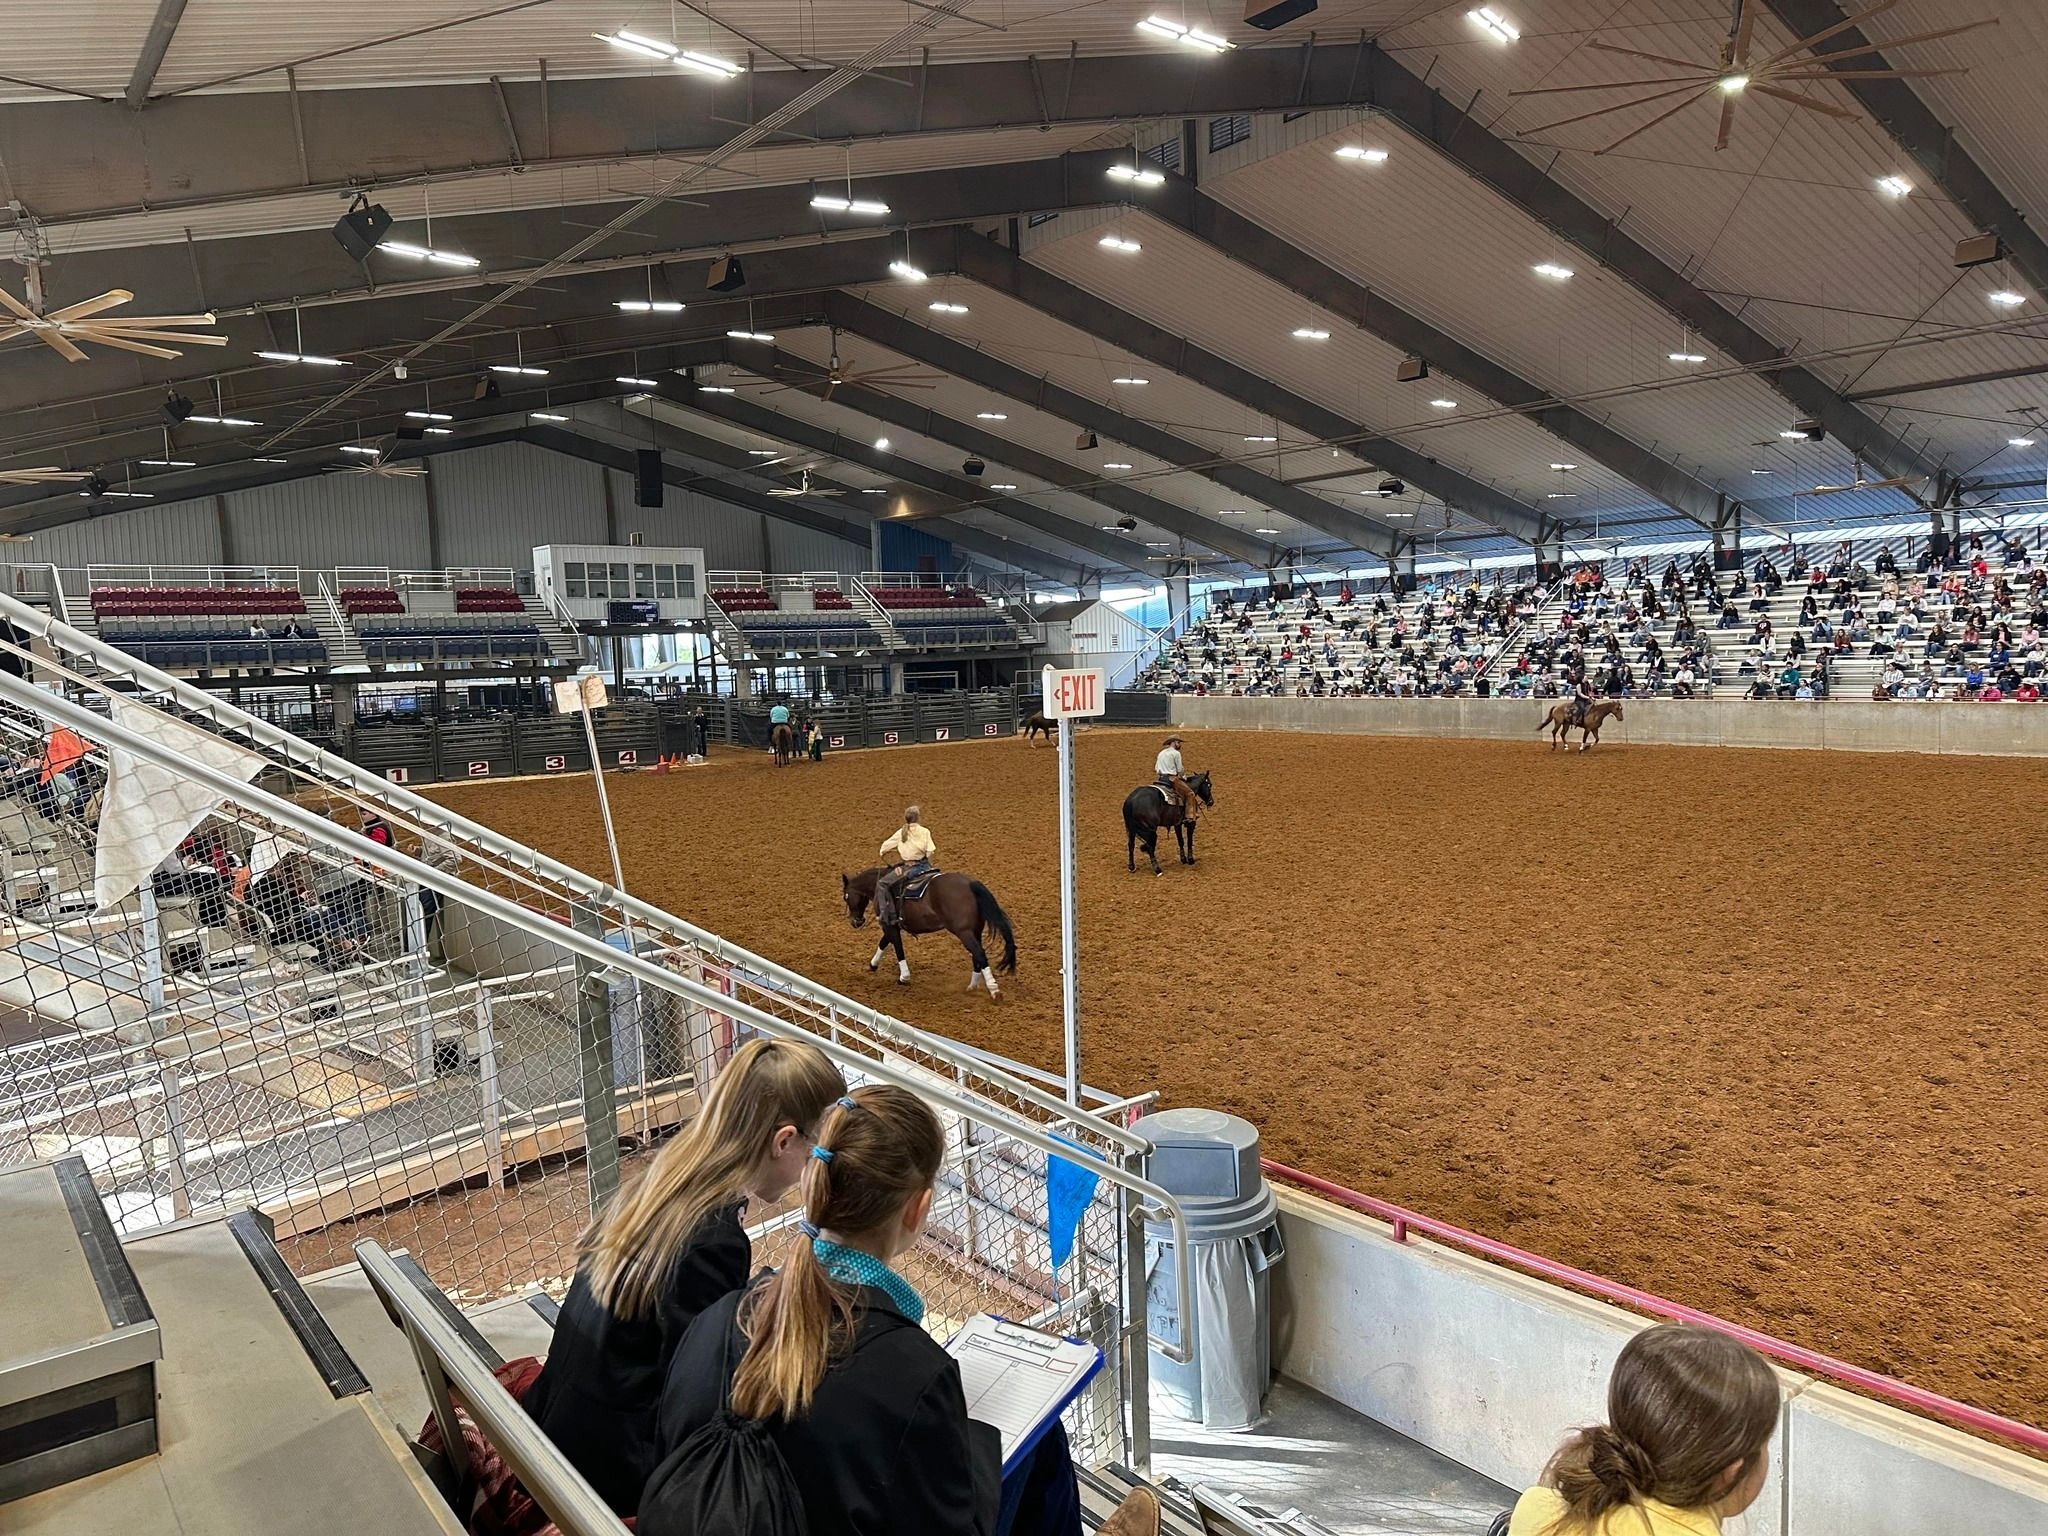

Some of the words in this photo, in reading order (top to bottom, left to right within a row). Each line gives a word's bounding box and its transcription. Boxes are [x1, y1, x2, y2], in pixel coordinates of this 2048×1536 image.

[1061, 674, 1096, 712] EXIT
[937, 729, 947, 738] 7
[985, 725, 996, 734] 8
[831, 735, 843, 745] 5
[885, 733, 897, 743] 6
[547, 756, 564, 769] 3
[620, 751, 635, 763] 4
[470, 762, 488, 775] 2
[390, 769, 403, 781] 1
